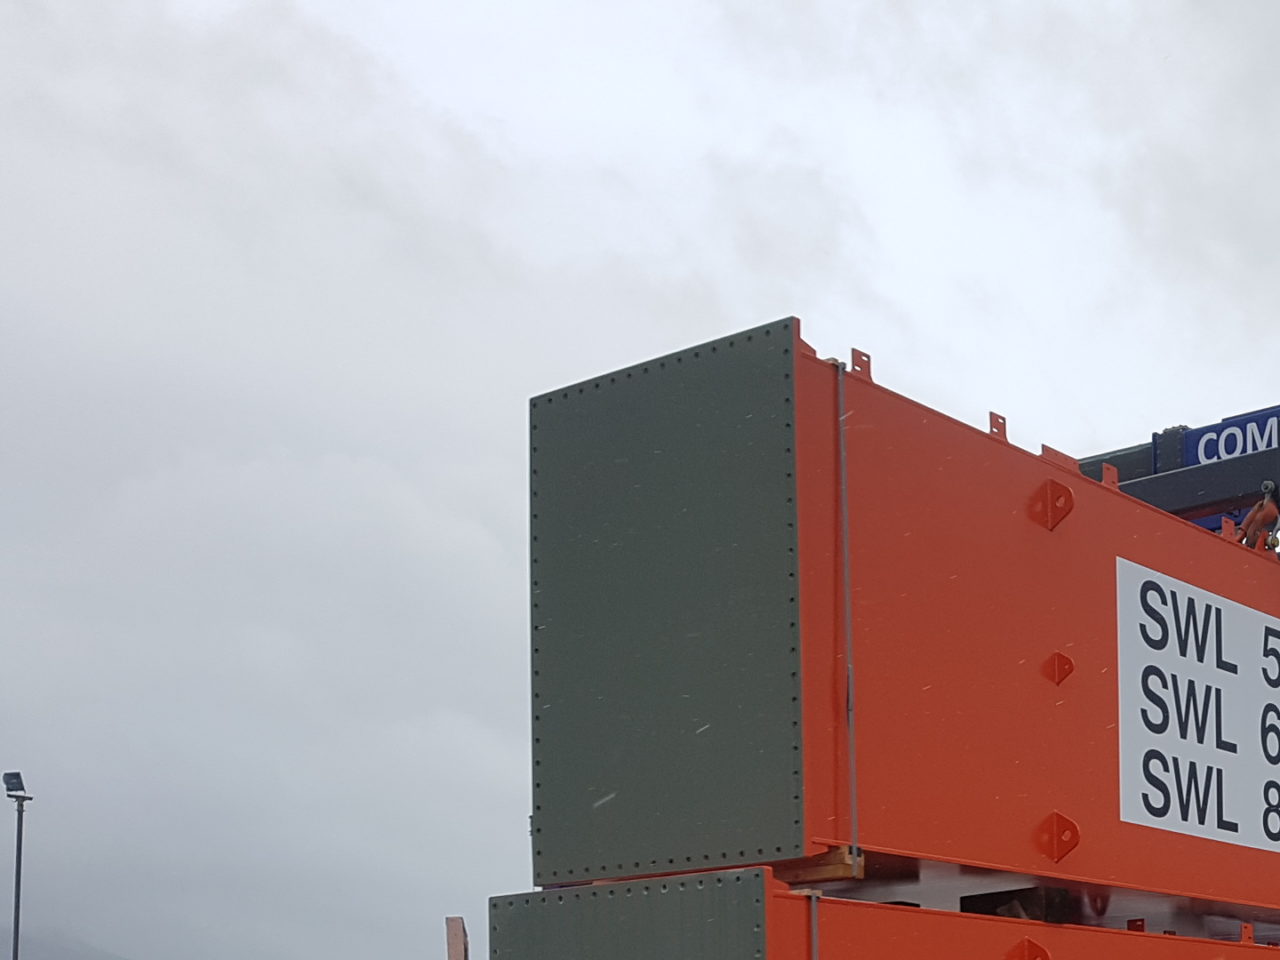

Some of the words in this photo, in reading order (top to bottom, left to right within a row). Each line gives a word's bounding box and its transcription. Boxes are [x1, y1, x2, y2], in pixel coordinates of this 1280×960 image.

[1139, 580, 1238, 675] SWL
[1140, 664, 1238, 754] SWL
[1141, 749, 1239, 833] SWL
